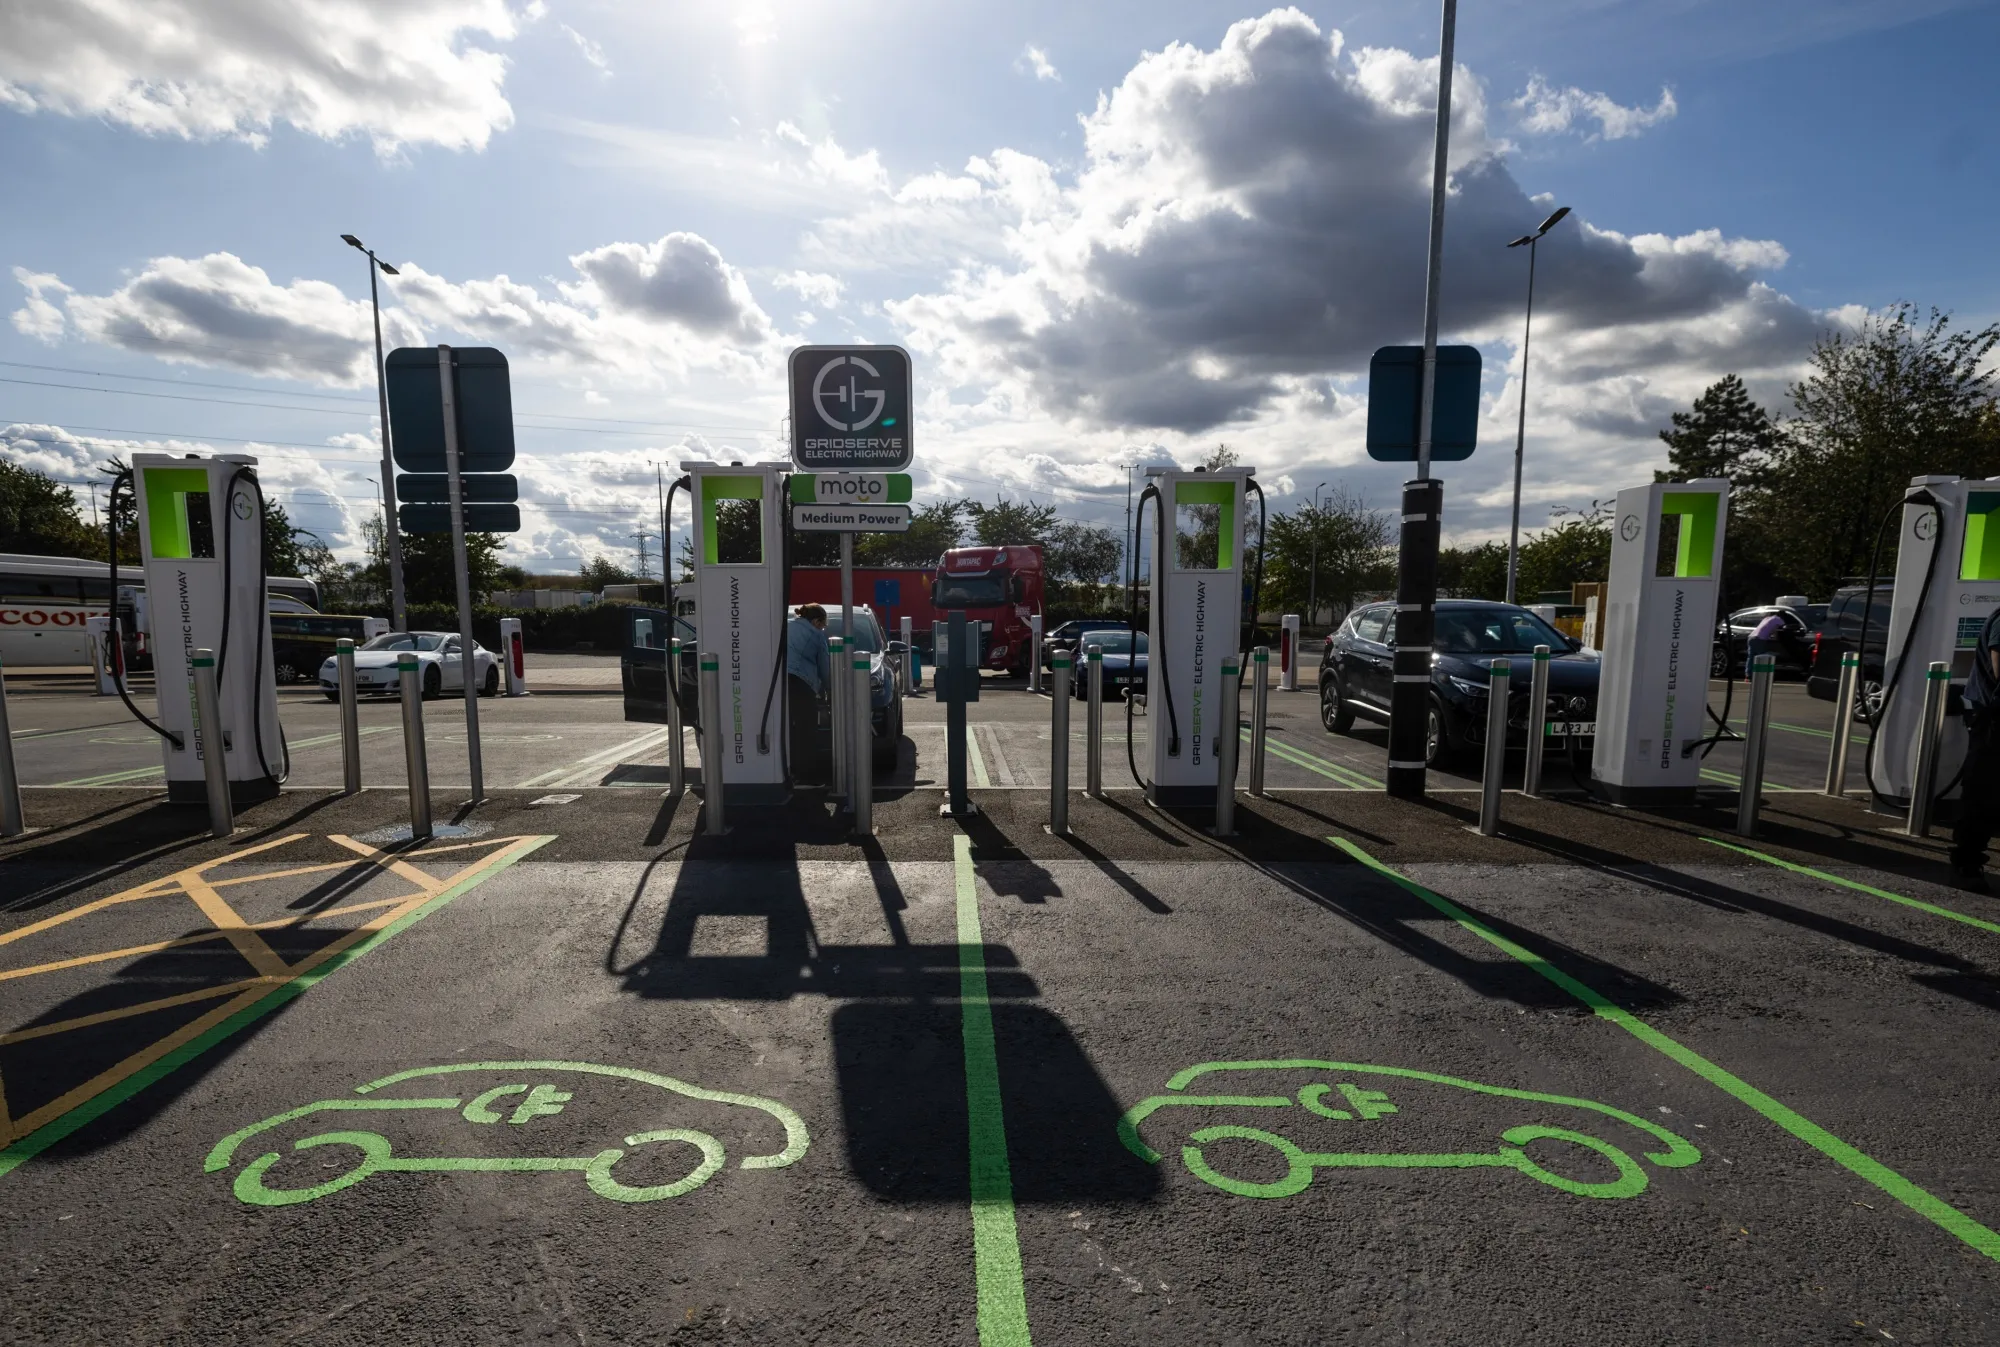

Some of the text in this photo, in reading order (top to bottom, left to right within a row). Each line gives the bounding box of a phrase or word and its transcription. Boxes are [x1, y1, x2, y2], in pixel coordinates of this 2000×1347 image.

[805, 438, 902, 450] GRIDSERVE
[805, 450, 902, 459] ELECTRIC HIGHWAY
[821, 476, 882, 495] moto
[802, 513, 900, 525] Medium Power
[177, 569, 191, 623] HIGHWAY
[730, 576, 744, 764] GRIDSERVE ELECTRIC HIGHWAY
[1192, 580, 1206, 766] GRIDSERVE ELECTRIC HIGHWAY
[1660, 589, 1684, 769] GRIDSERVE ELECTRIC HIGHWAY
